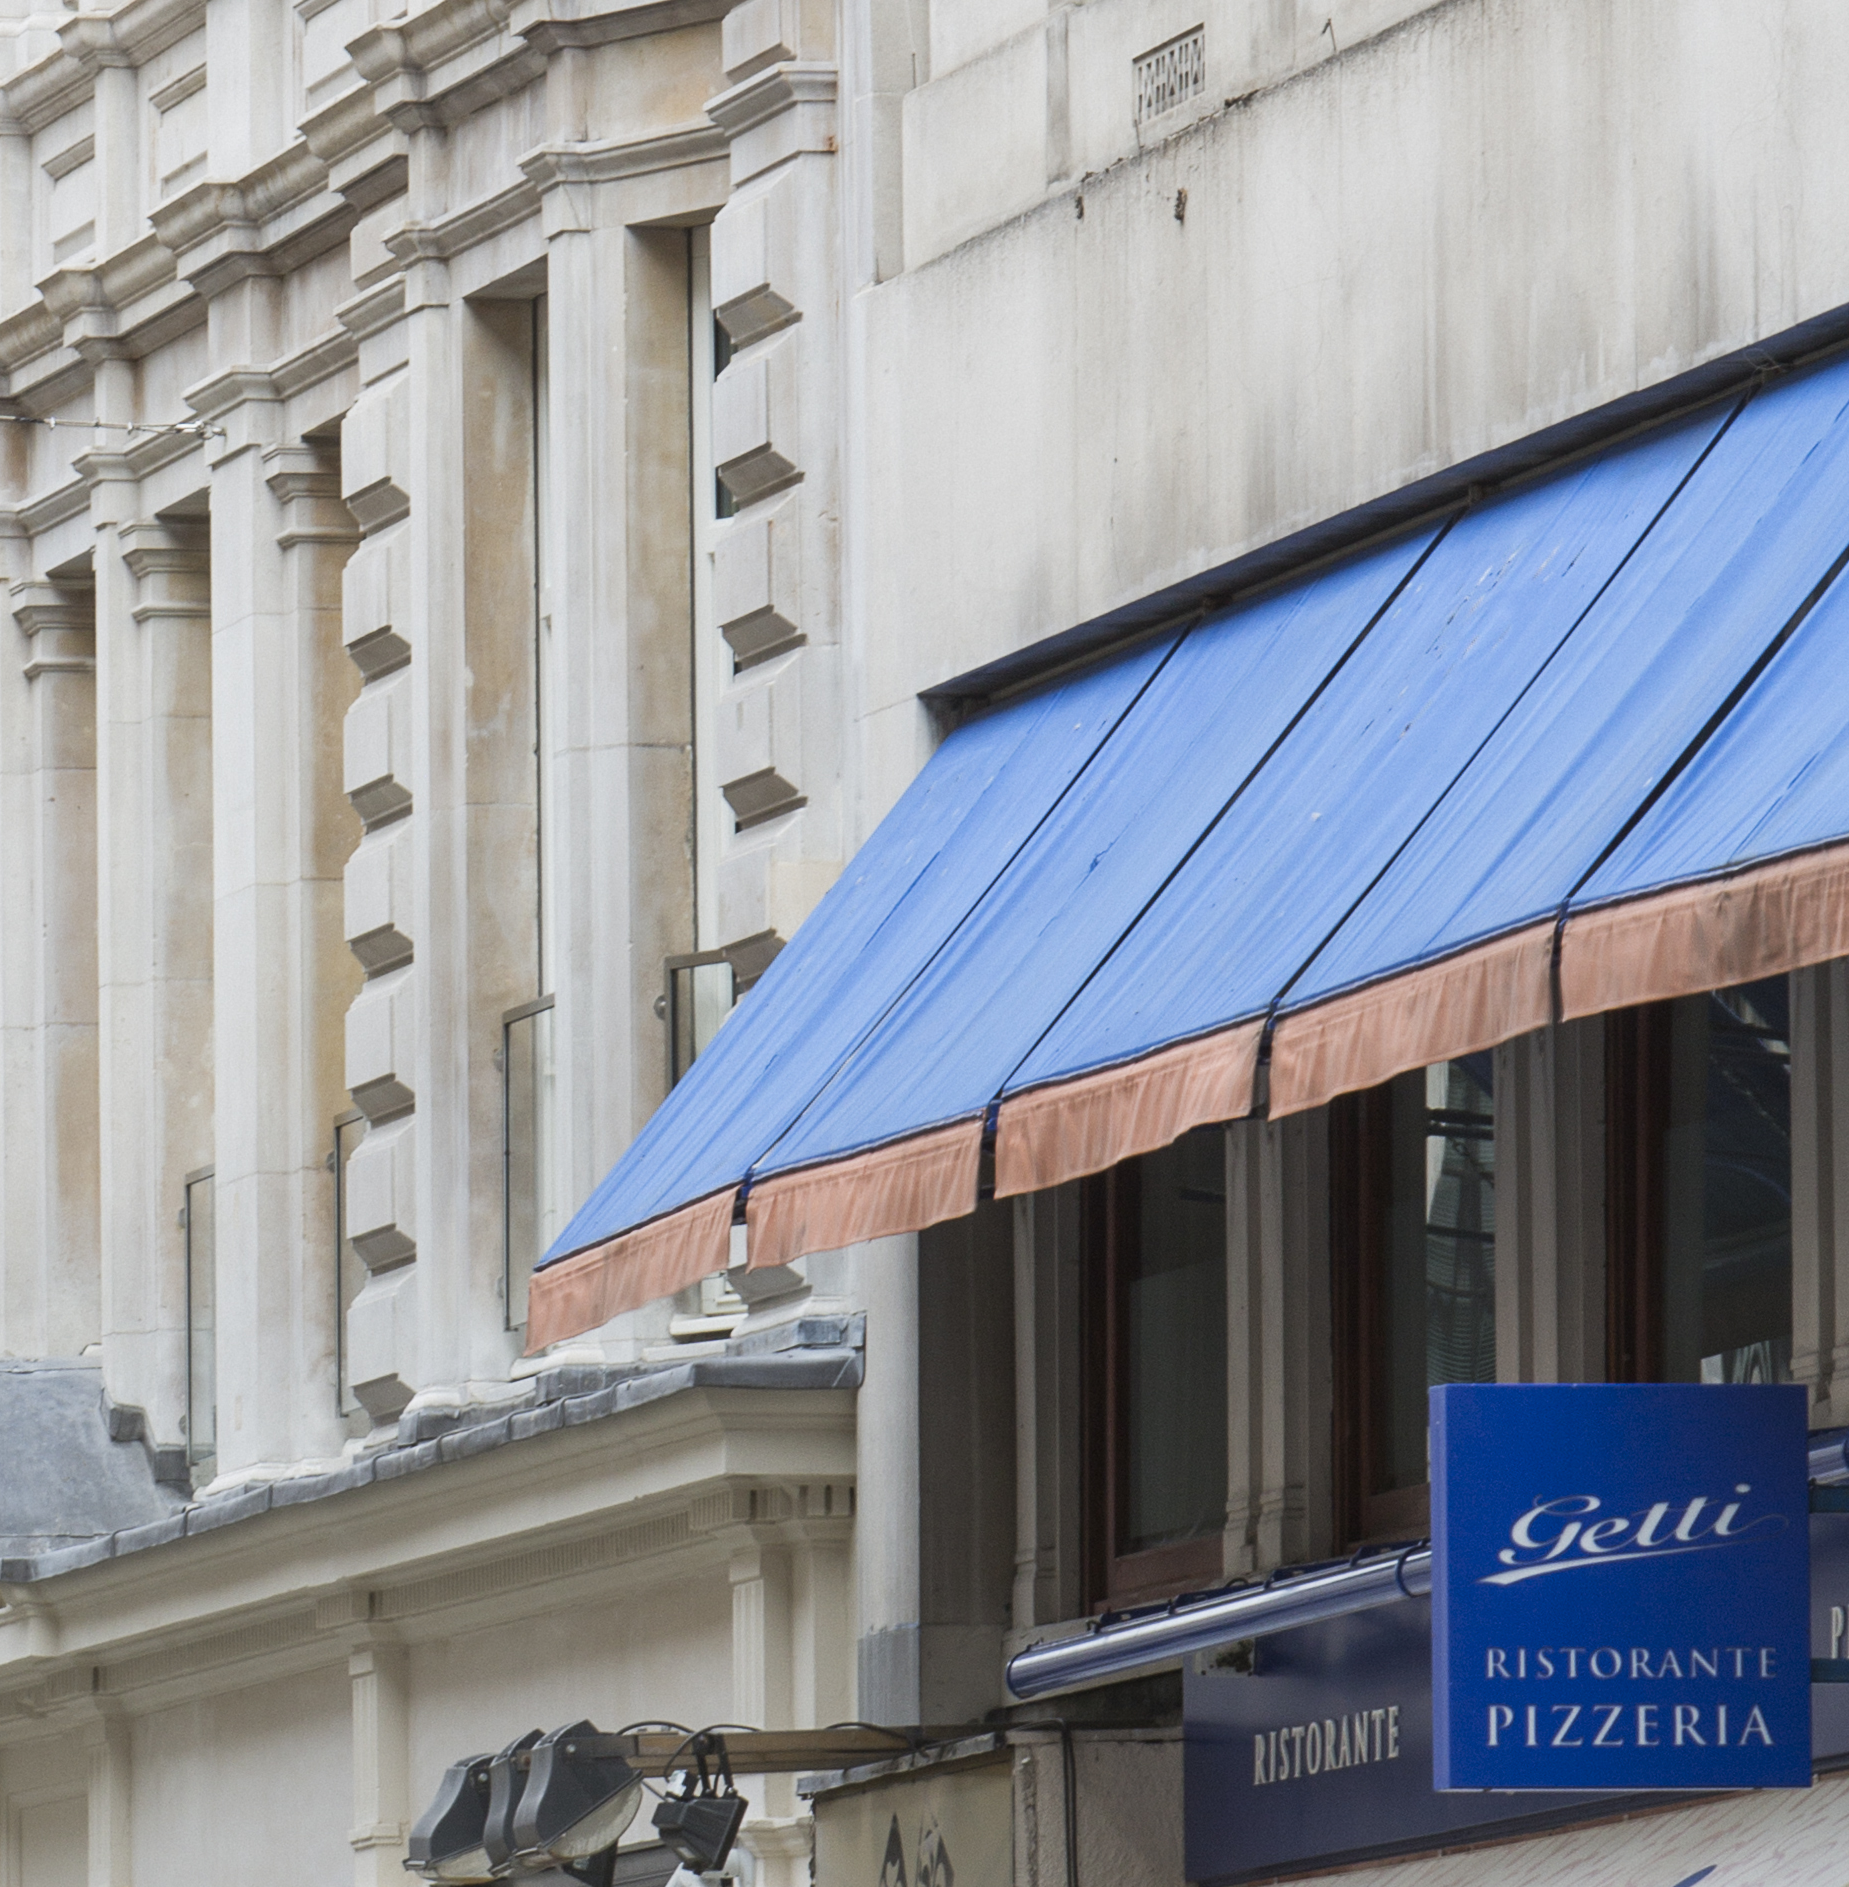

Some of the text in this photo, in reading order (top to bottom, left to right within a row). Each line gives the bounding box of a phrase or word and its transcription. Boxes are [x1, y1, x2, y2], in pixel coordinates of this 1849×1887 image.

[1477, 1483, 1791, 1585] Getti
[1485, 1647, 1778, 1679] RISTORANTE
[1253, 1705, 1400, 1787] RISTORANTE
[1485, 1703, 1775, 1748] PIZZERIA
